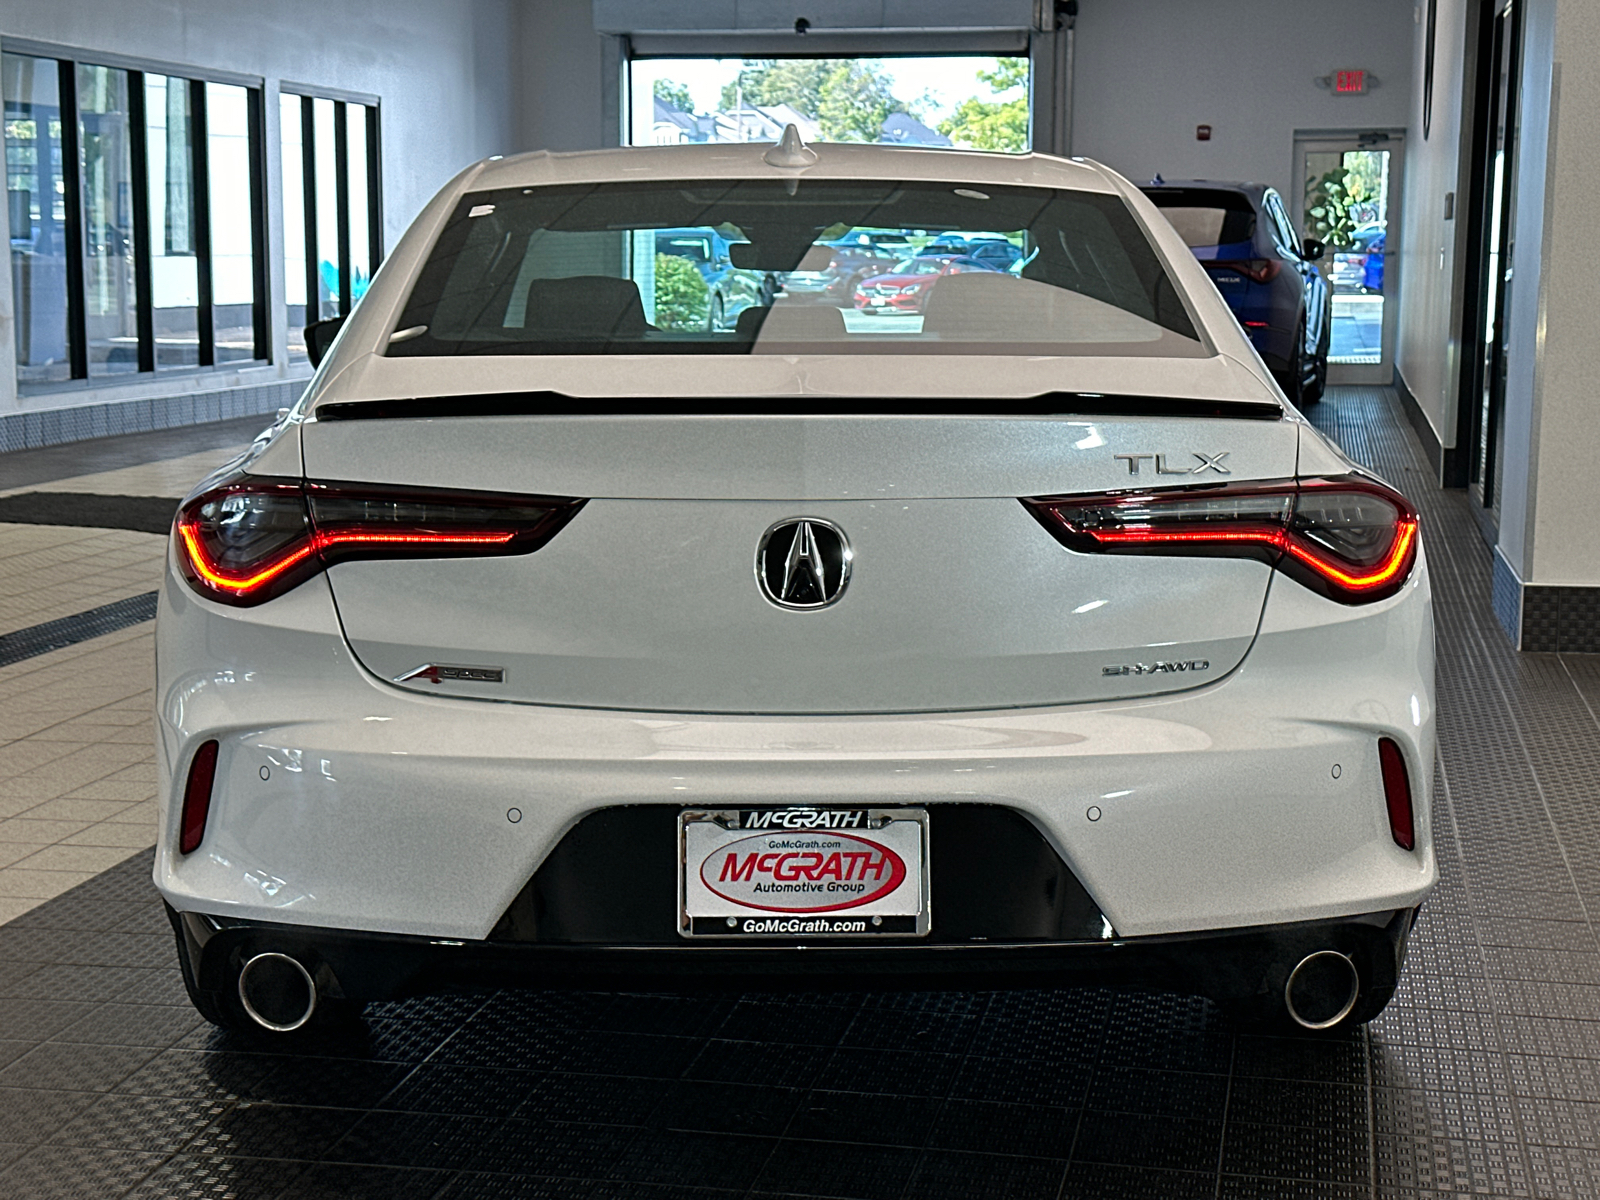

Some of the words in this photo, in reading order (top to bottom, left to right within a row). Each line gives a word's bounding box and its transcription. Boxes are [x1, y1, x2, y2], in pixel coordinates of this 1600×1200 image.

[1336, 70, 1364, 92] EXIT
[1113, 452, 1231, 475] TLX
[768, 840, 841, 849] GoMcGrath.com
[753, 882, 824, 892] Automotive
[827, 882, 865, 894] Group
[743, 919, 866, 933] GoMcGrath.com
